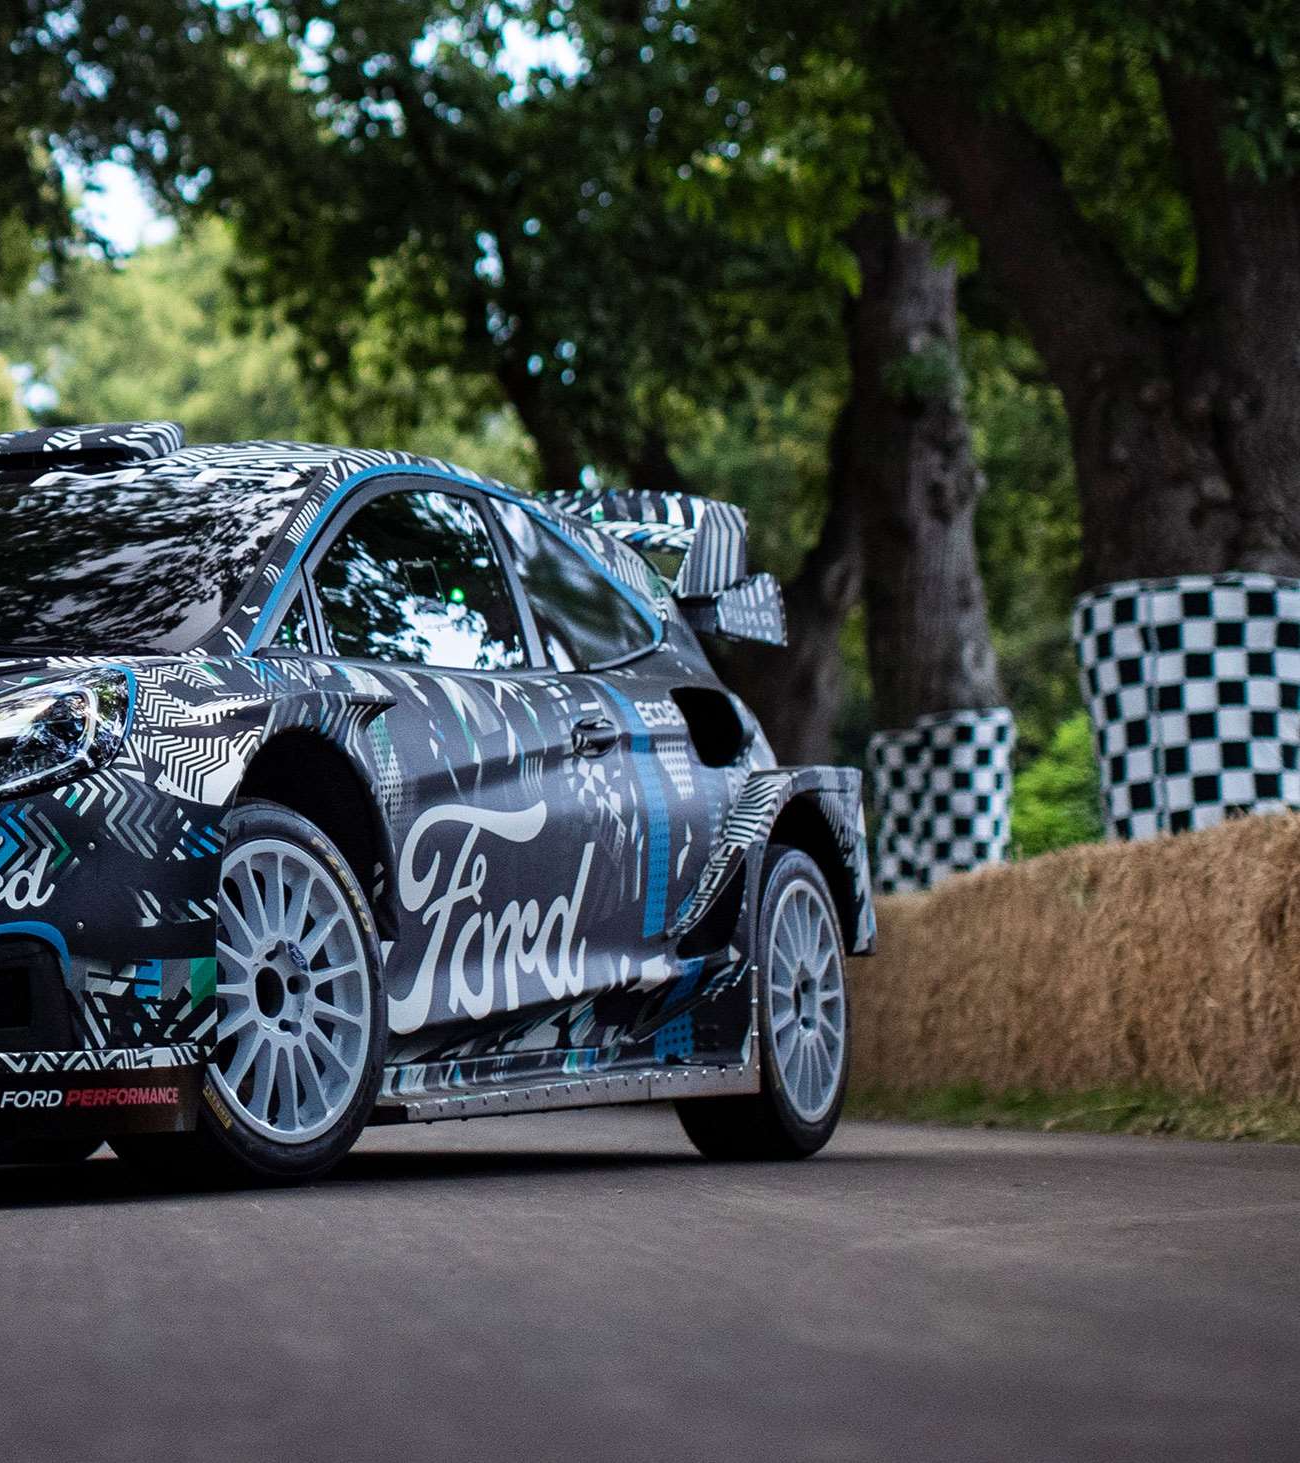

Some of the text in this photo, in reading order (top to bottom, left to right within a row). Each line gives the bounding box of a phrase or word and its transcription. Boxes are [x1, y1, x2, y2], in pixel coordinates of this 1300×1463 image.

[381, 800, 595, 1035] Ford
[0, 1087, 179, 1108] FORD PERFORMANCE
